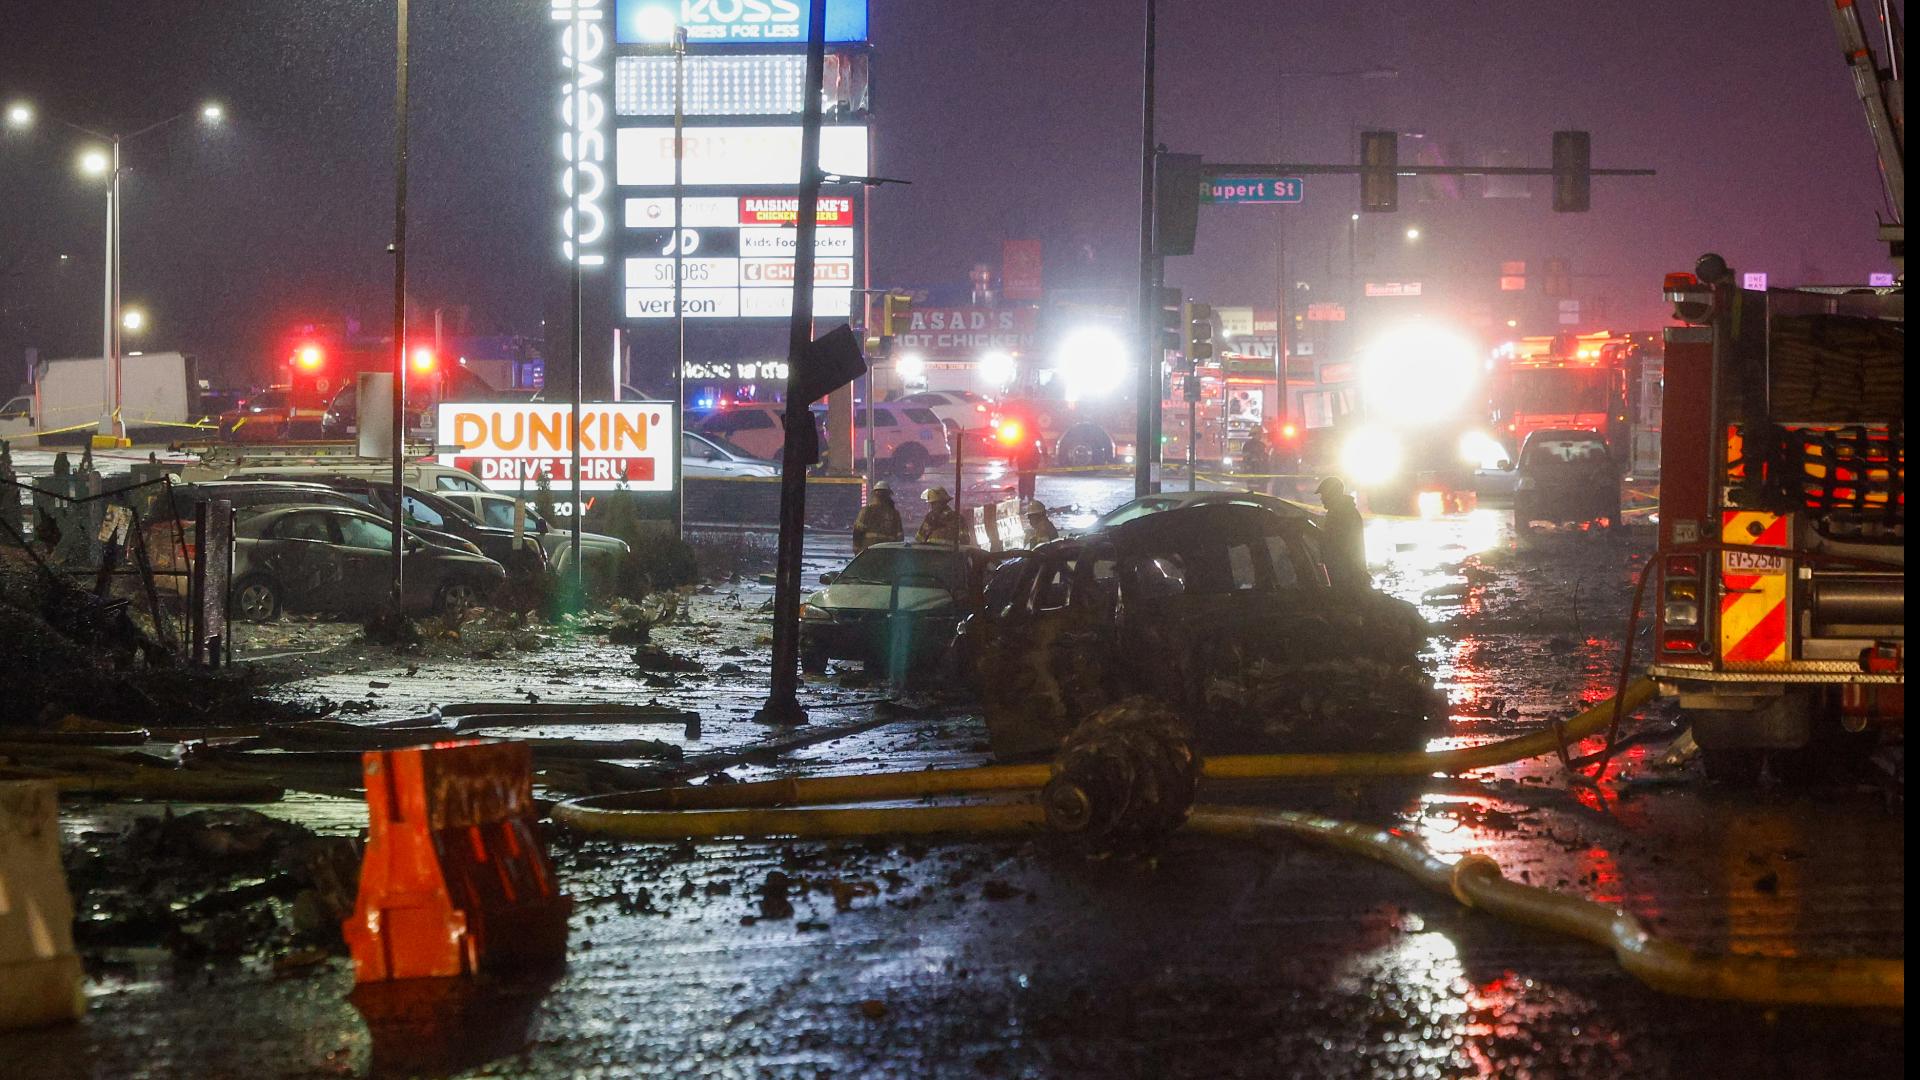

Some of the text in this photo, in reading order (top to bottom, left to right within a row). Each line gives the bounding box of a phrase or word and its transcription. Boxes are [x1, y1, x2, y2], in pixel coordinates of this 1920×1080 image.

[680, 0, 800, 23] ROSS
[730, 24, 760, 38] FOR
[763, 24, 800, 38] LESS
[1200, 181, 1295, 200] Rupert St
[745, 199, 800, 212] RAISING
[756, 211, 798, 221] CHICKEN
[662, 228, 700, 256] JD
[745, 237, 847, 247] Kids Foo ocker
[767, 265, 848, 280] CHITLE
[638, 295, 716, 313] verizon
[910, 312, 1014, 331] ASAD'S
[891, 334, 1035, 348] HOT CHICKEN
[454, 411, 660, 452] DUNKIN'
[481, 458, 629, 480] DRIVE THRU
